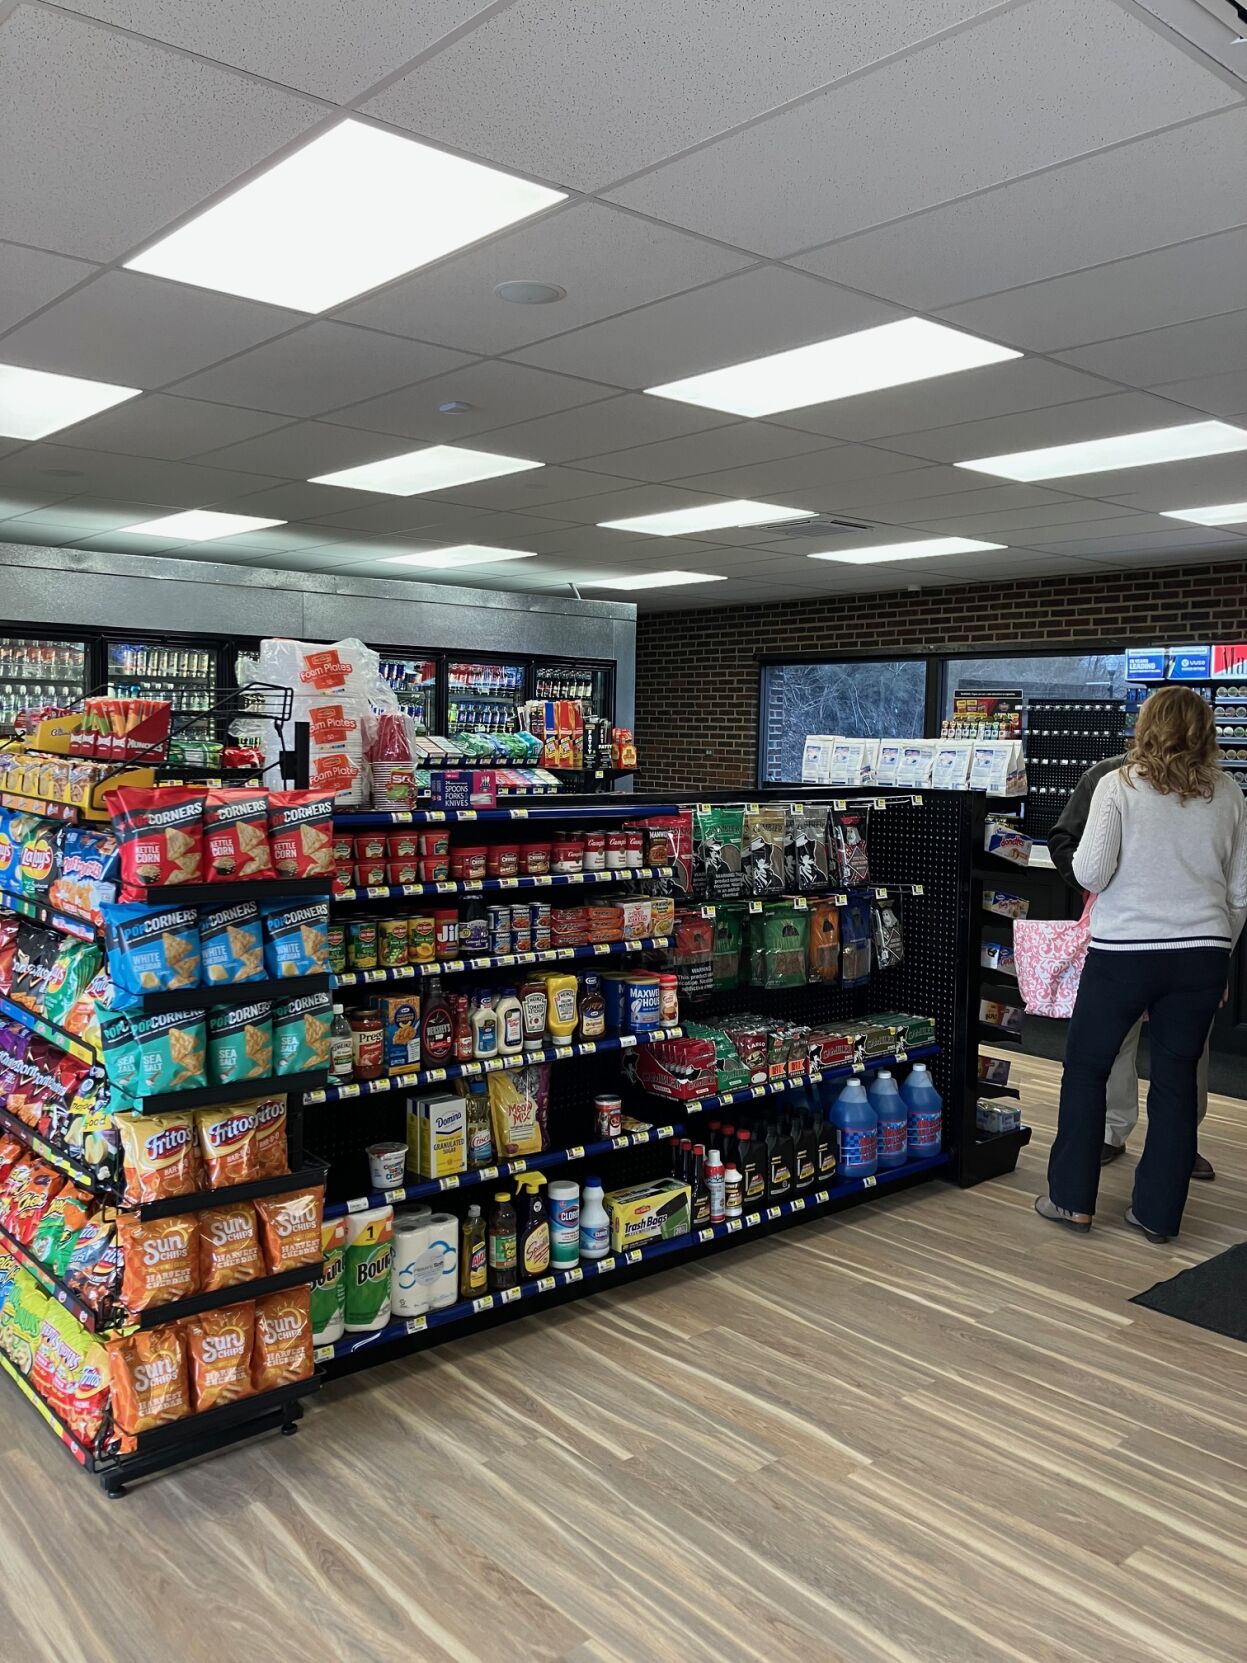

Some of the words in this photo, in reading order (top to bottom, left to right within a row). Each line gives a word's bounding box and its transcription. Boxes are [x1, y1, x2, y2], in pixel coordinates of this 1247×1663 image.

[301, 668, 323, 680] Foam
[324, 662, 352, 674] Plates
[310, 722, 326, 733] oam
[327, 718, 355, 729] Plates
[309, 771, 332, 784] Foam
[445, 785, 469, 793] SPOONS
[445, 792, 465, 800] FORKS
[445, 799, 469, 807] KNIVES
[206, 800, 267, 823] OPCORNERS
[272, 801, 332, 826] OPCORNERS
[136, 845, 160, 854] KETTLE
[210, 839, 233, 849] KETTLE
[274, 842, 296, 851] KETTLE
[211, 846, 235, 857] CORN
[275, 849, 297, 859] CORN
[136, 853, 160, 864] CORN
[200, 900, 257, 930] OPCORNERS
[125, 908, 198, 940] POPCORNERS
[437, 924, 459, 942] Jif
[202, 944, 226, 958] WHITE
[276, 943, 299, 955] WHITE
[133, 952, 160, 965] WHITE
[629, 988, 660, 999] MAXWE
[642, 998, 660, 1007] HOUS
[281, 1037, 298, 1046] SEA
[219, 1049, 237, 1059] SEA
[281, 1044, 298, 1053] SALT
[117, 1055, 135, 1065] SEA
[143, 1053, 162, 1064] SEA
[219, 1057, 237, 1067] SALT
[144, 1062, 162, 1072] SALT
[256, 1102, 285, 1127] ritos
[436, 1112, 462, 1128] Domino
[207, 1115, 256, 1148] Fritos
[144, 1127, 192, 1160] Fritos
[433, 1138, 465, 1151] GRANULATED
[561, 1211, 579, 1221] CLORO
[210, 1215, 252, 1245] Sun
[291, 1221, 317, 1232] CHIPS
[624, 1219, 647, 1234] Trash
[646, 1214, 668, 1227] Bags
[225, 1228, 253, 1242] CHIPS
[366, 1225, 374, 1239] 1
[143, 1234, 185, 1266] Sun
[159, 1248, 188, 1261] CHIPS
[146, 1268, 191, 1282] HARVEST
[264, 1316, 303, 1344] Sun
[277, 1327, 303, 1341] CHIPS
[202, 1333, 243, 1363] Sun
[217, 1345, 245, 1358] CHIPS
[134, 1359, 174, 1392] Sun
[150, 1370, 178, 1387] CHIPS
